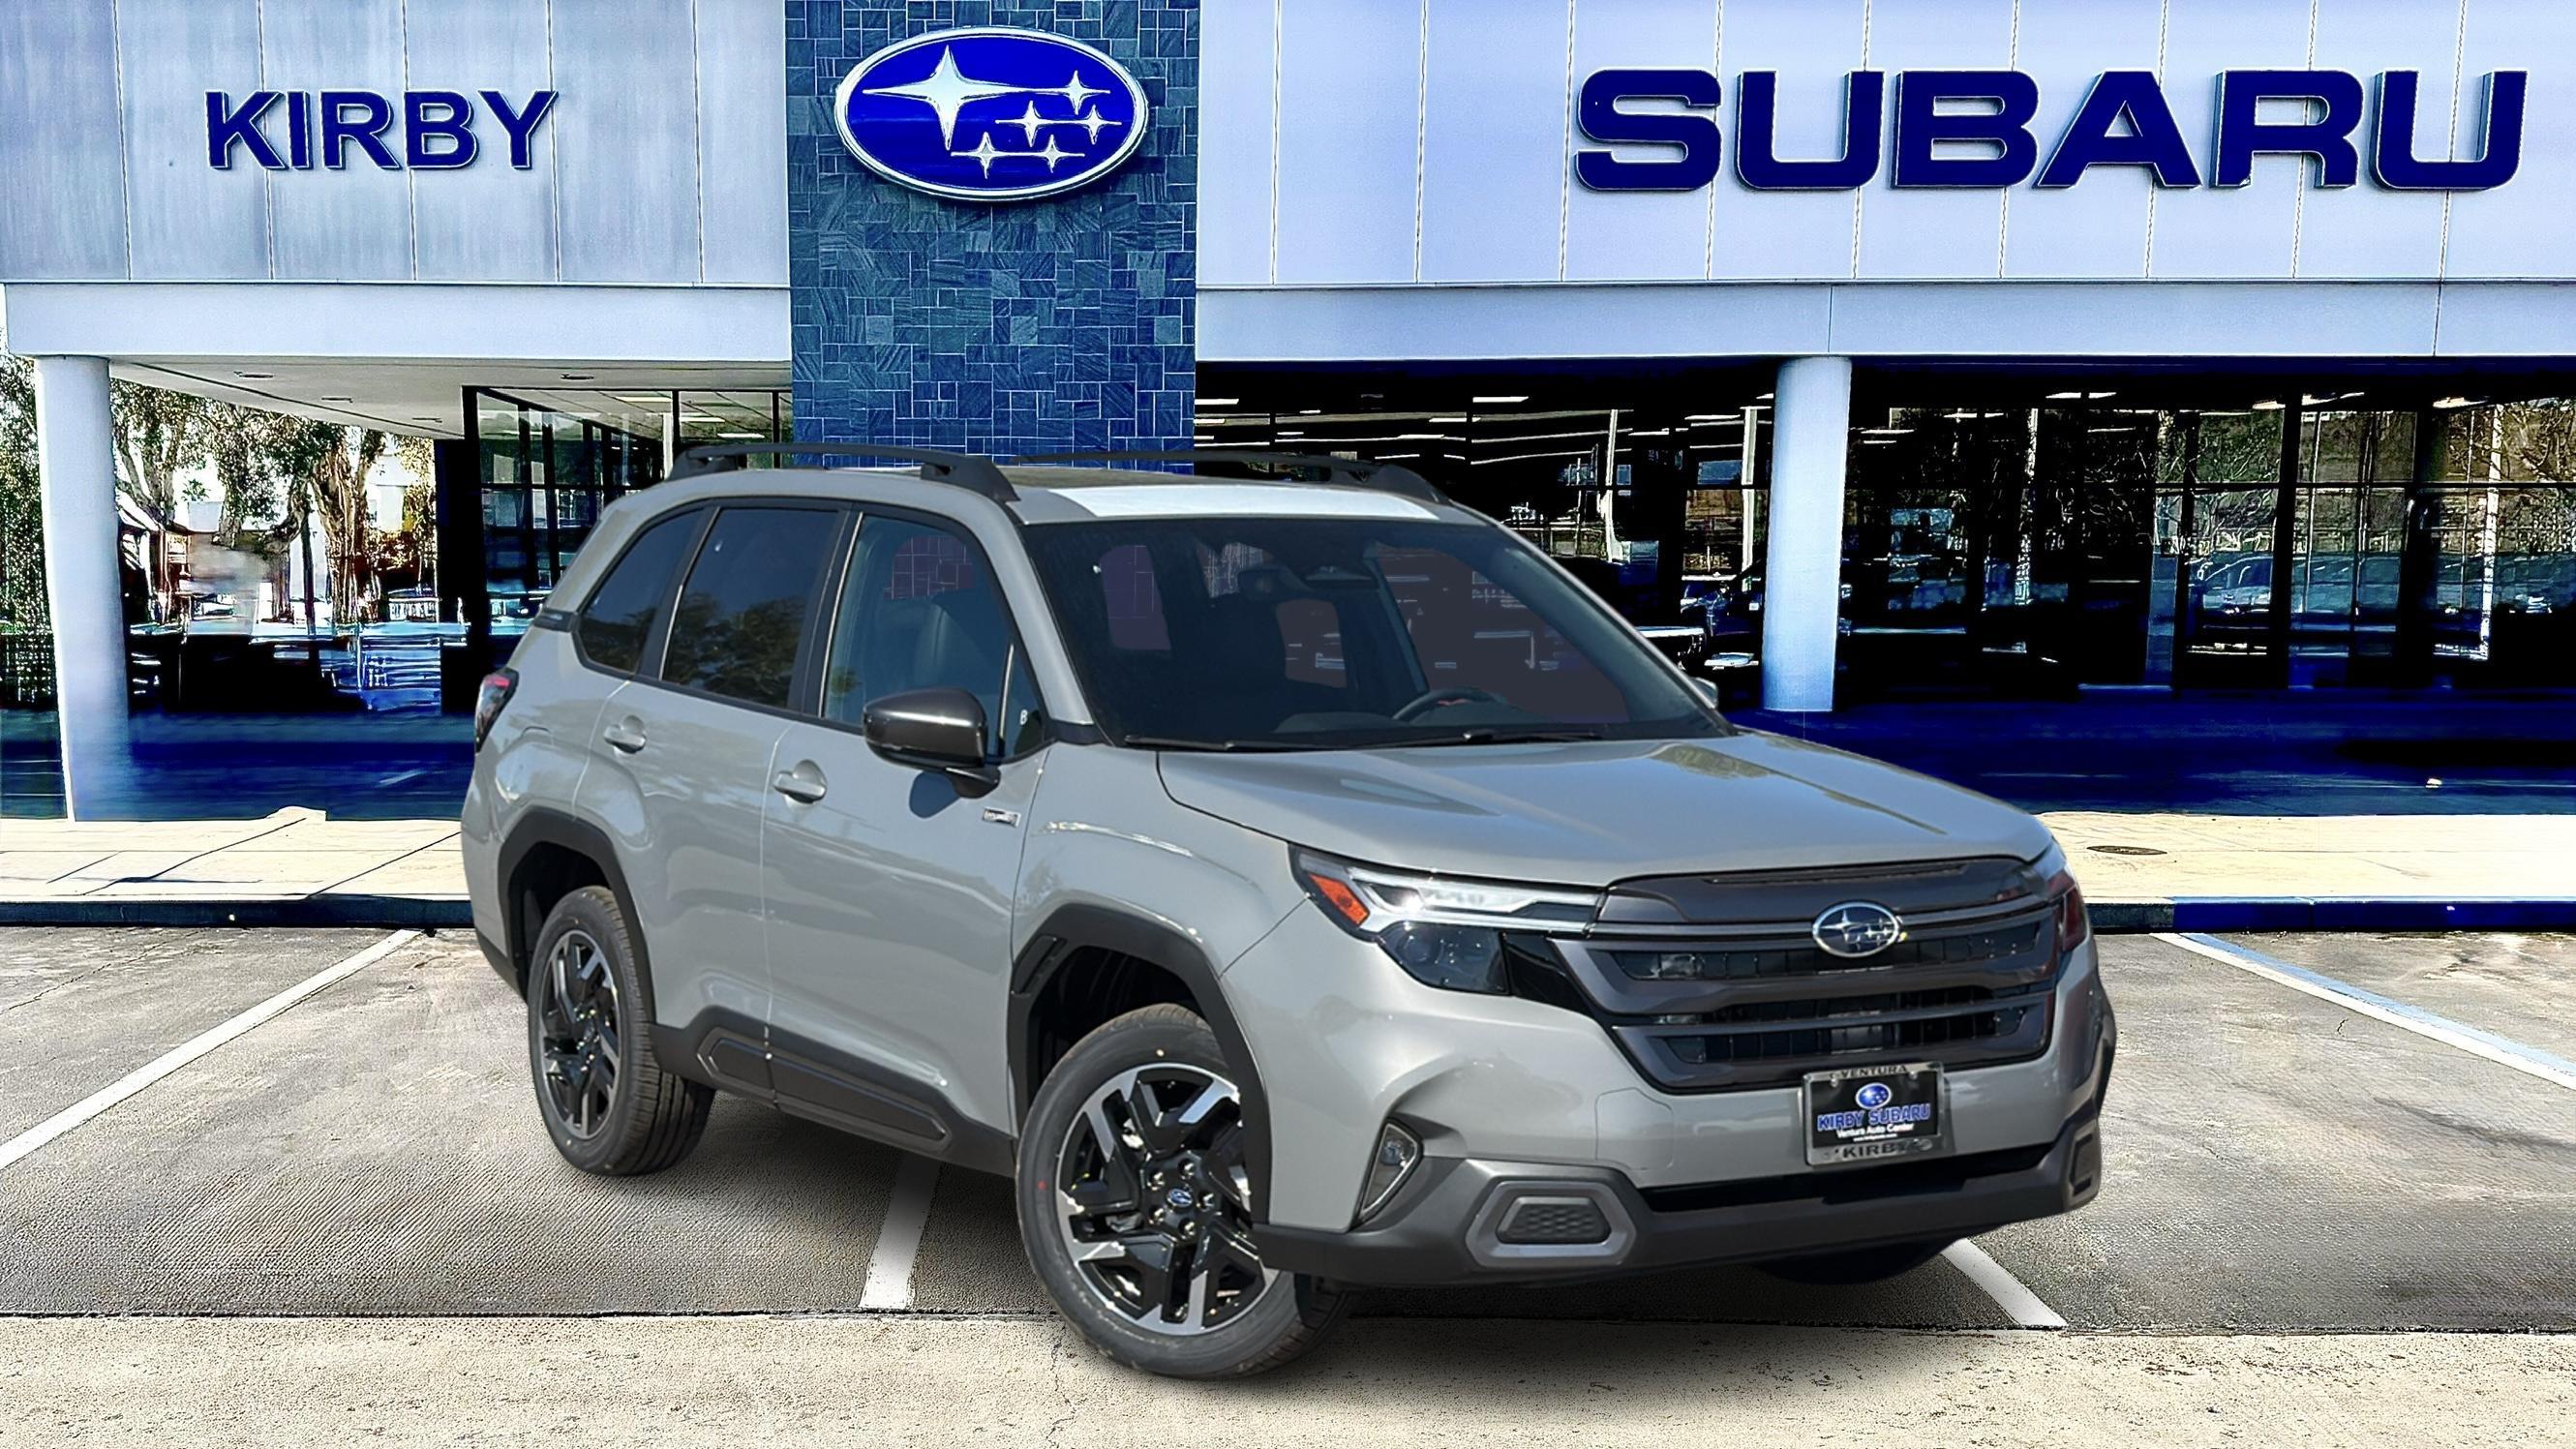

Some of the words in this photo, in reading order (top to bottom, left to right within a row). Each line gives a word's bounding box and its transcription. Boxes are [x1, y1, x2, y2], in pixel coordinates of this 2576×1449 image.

[205, 90, 559, 169] KIRBY
[1575, 69, 2528, 191] SUBARU
[1840, 1065, 1907, 1078] VENTURA
[1817, 1110, 1865, 1132] KIRBY
[1868, 1103, 1930, 1126] SUBARU
[1866, 1125, 1886, 1134] Auto
